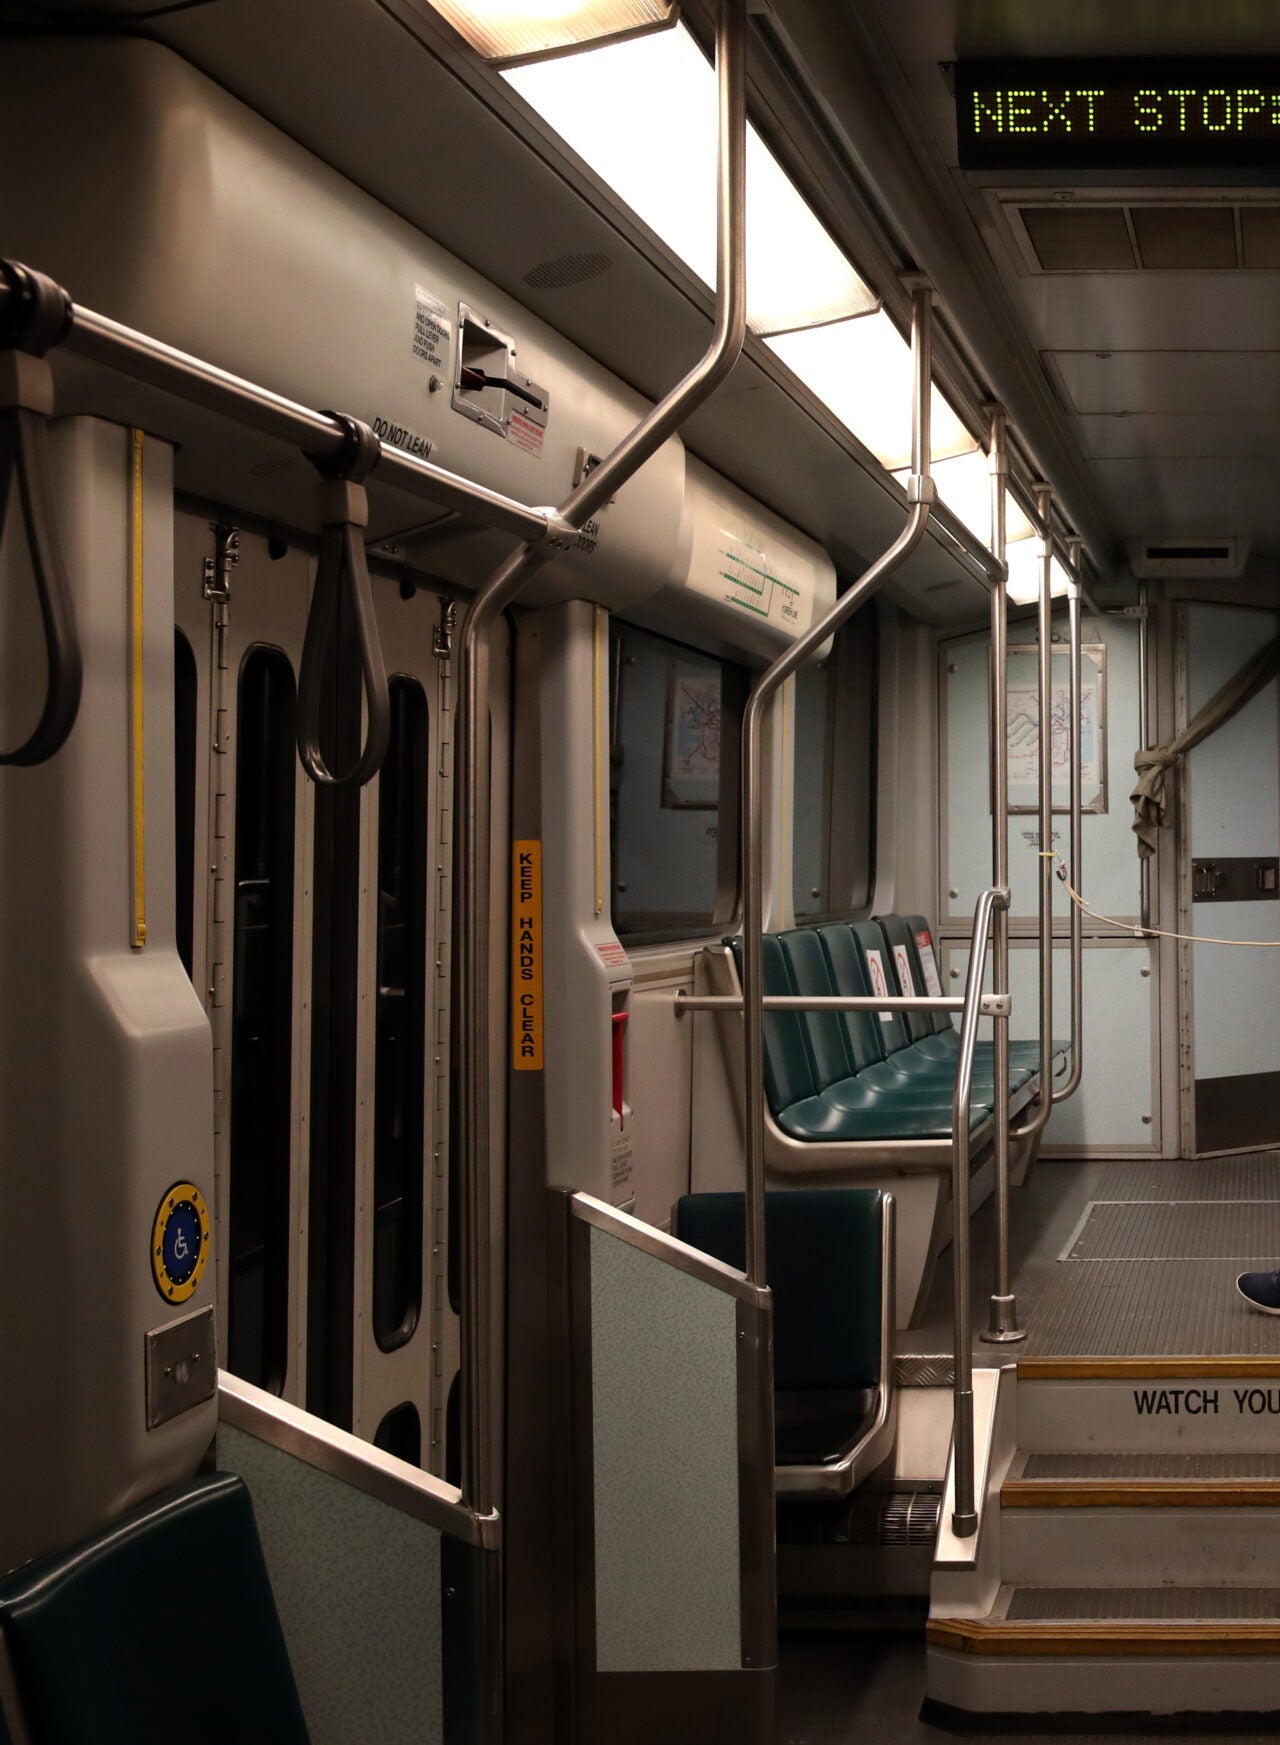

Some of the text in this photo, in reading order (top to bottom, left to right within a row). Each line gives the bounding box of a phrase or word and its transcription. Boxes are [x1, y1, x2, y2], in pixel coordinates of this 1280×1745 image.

[973, 90, 1105, 133] NEXT
[372, 417, 432, 458] DO NOT LEAN
[519, 852, 534, 1057] KEEP HANDS CLEAR
[1133, 1389, 1219, 1415] WATCH
